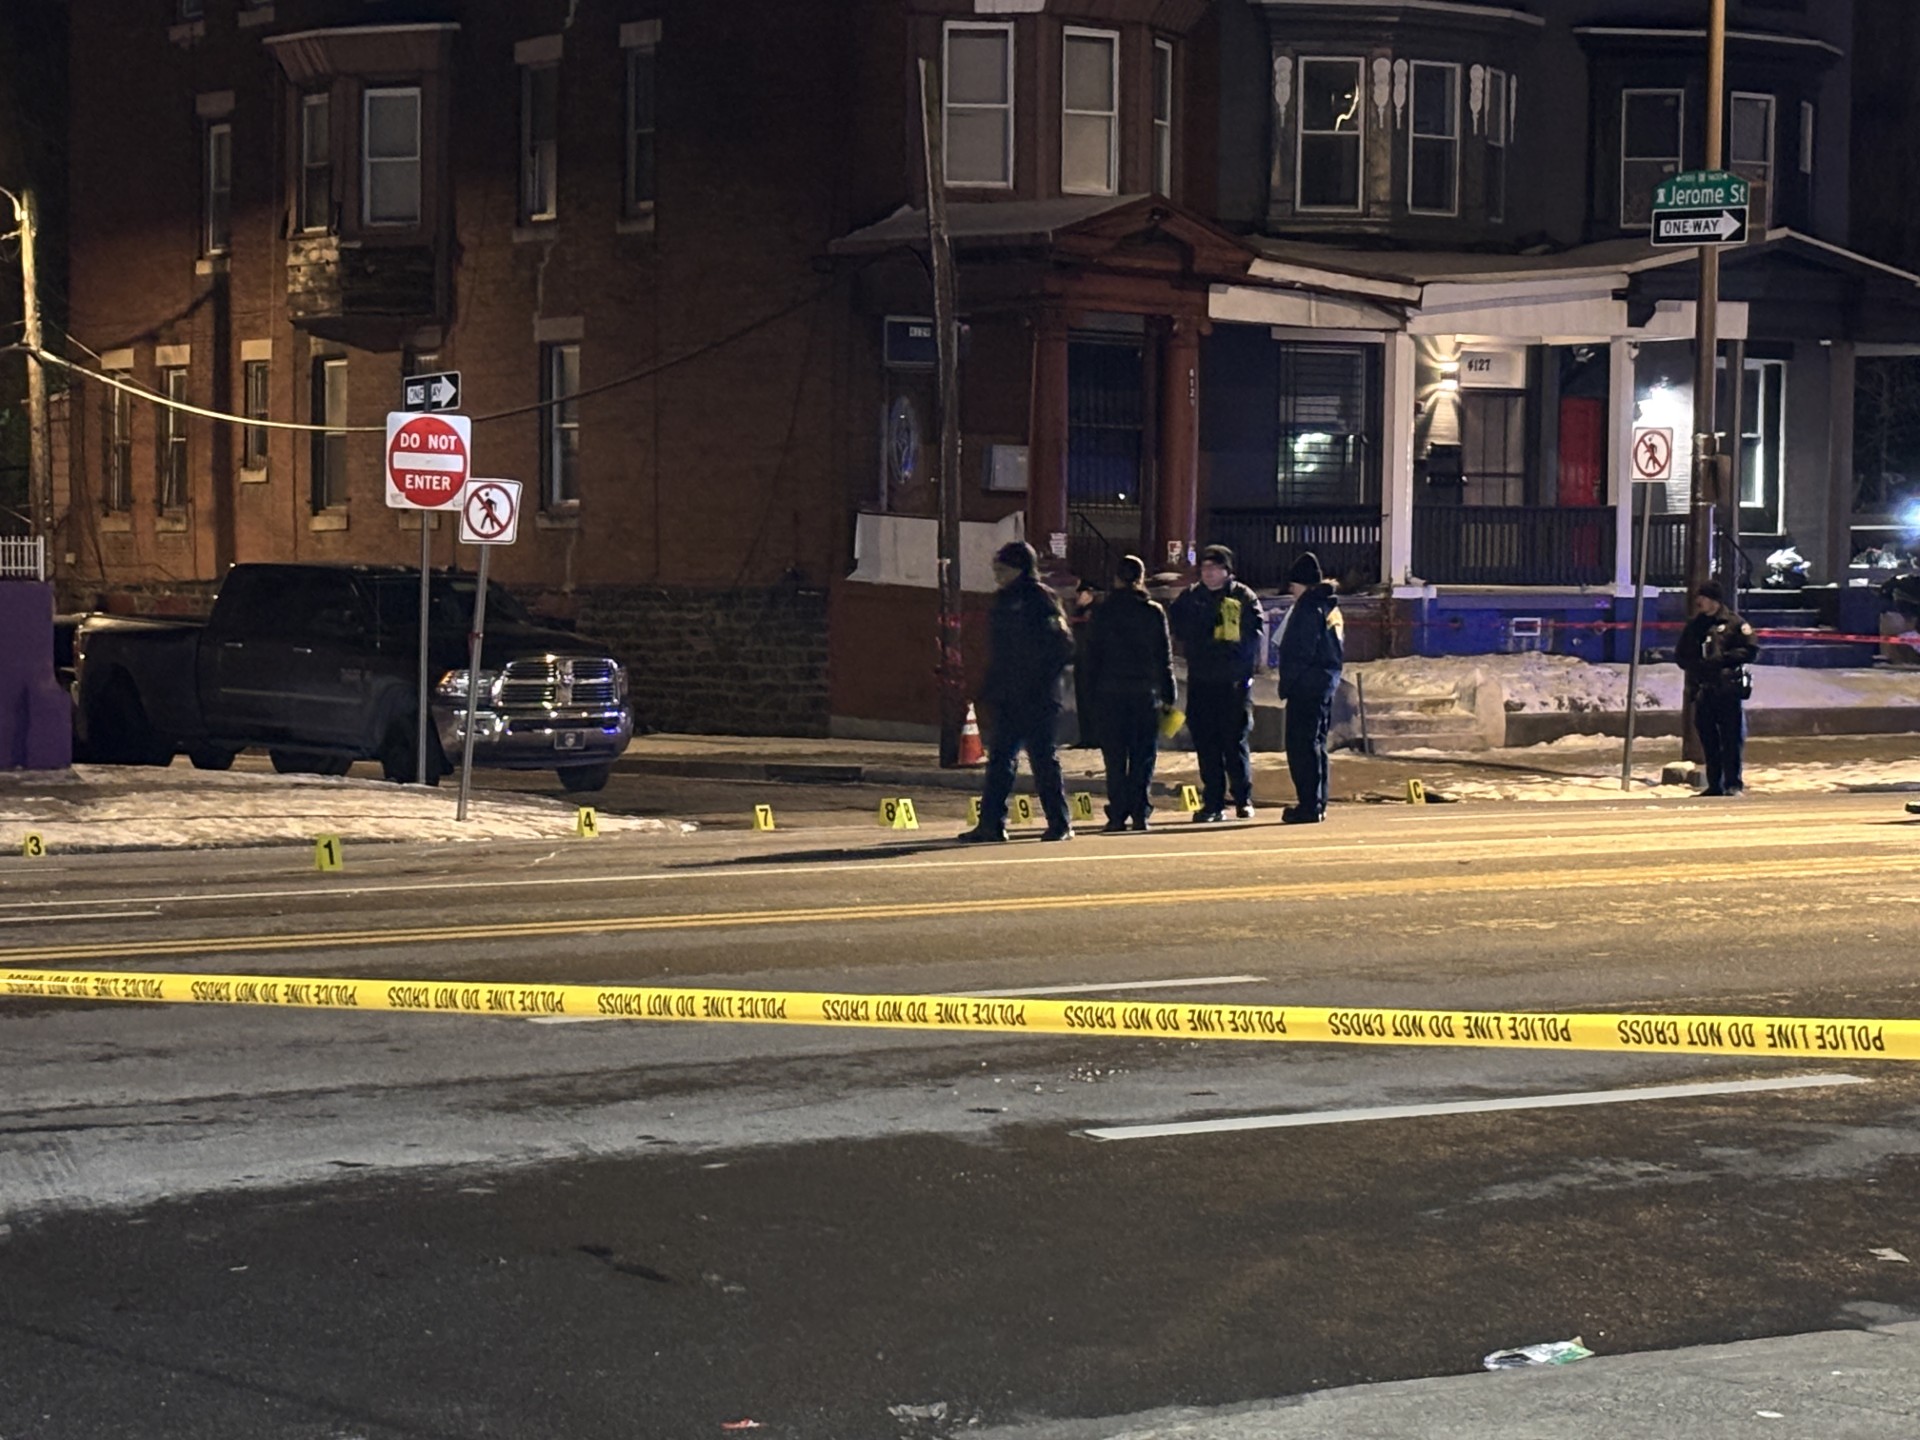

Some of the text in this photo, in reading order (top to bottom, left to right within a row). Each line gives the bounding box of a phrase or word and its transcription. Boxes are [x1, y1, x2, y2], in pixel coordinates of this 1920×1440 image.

[1668, 184, 1745, 206] Jerome St
[1664, 219, 1720, 234] ONE WAY
[400, 432, 457, 450] DO NOT
[405, 474, 451, 491] ENTER
[1188, 789, 1197, 806] A
[1413, 782, 1422, 799] C
[885, 802, 896, 822] 8
[1018, 799, 1029, 818] 9
[1077, 795, 1091, 814] 10
[583, 811, 594, 831] 4
[758, 808, 769, 827] 7
[29, 836, 42, 855] 3
[323, 840, 334, 864] 1
[189, 981, 358, 1006] POLICE LINE DO NOT CROSS
[388, 987, 564, 1013] POLICE LINE DO NOT CROSS
[598, 993, 787, 1019] POLICE LINE DO NOT CROSS
[822, 1000, 1026, 1026] POLICE LINE DO NOT CROSS
[1064, 1006, 1286, 1034] POLICE LINE DO NOT CROSS
[1328, 1013, 1571, 1042] POLICE LINE DO NOT CROSS
[1618, 1020, 1885, 1051] POLICE LINE DO NOT CROSS
